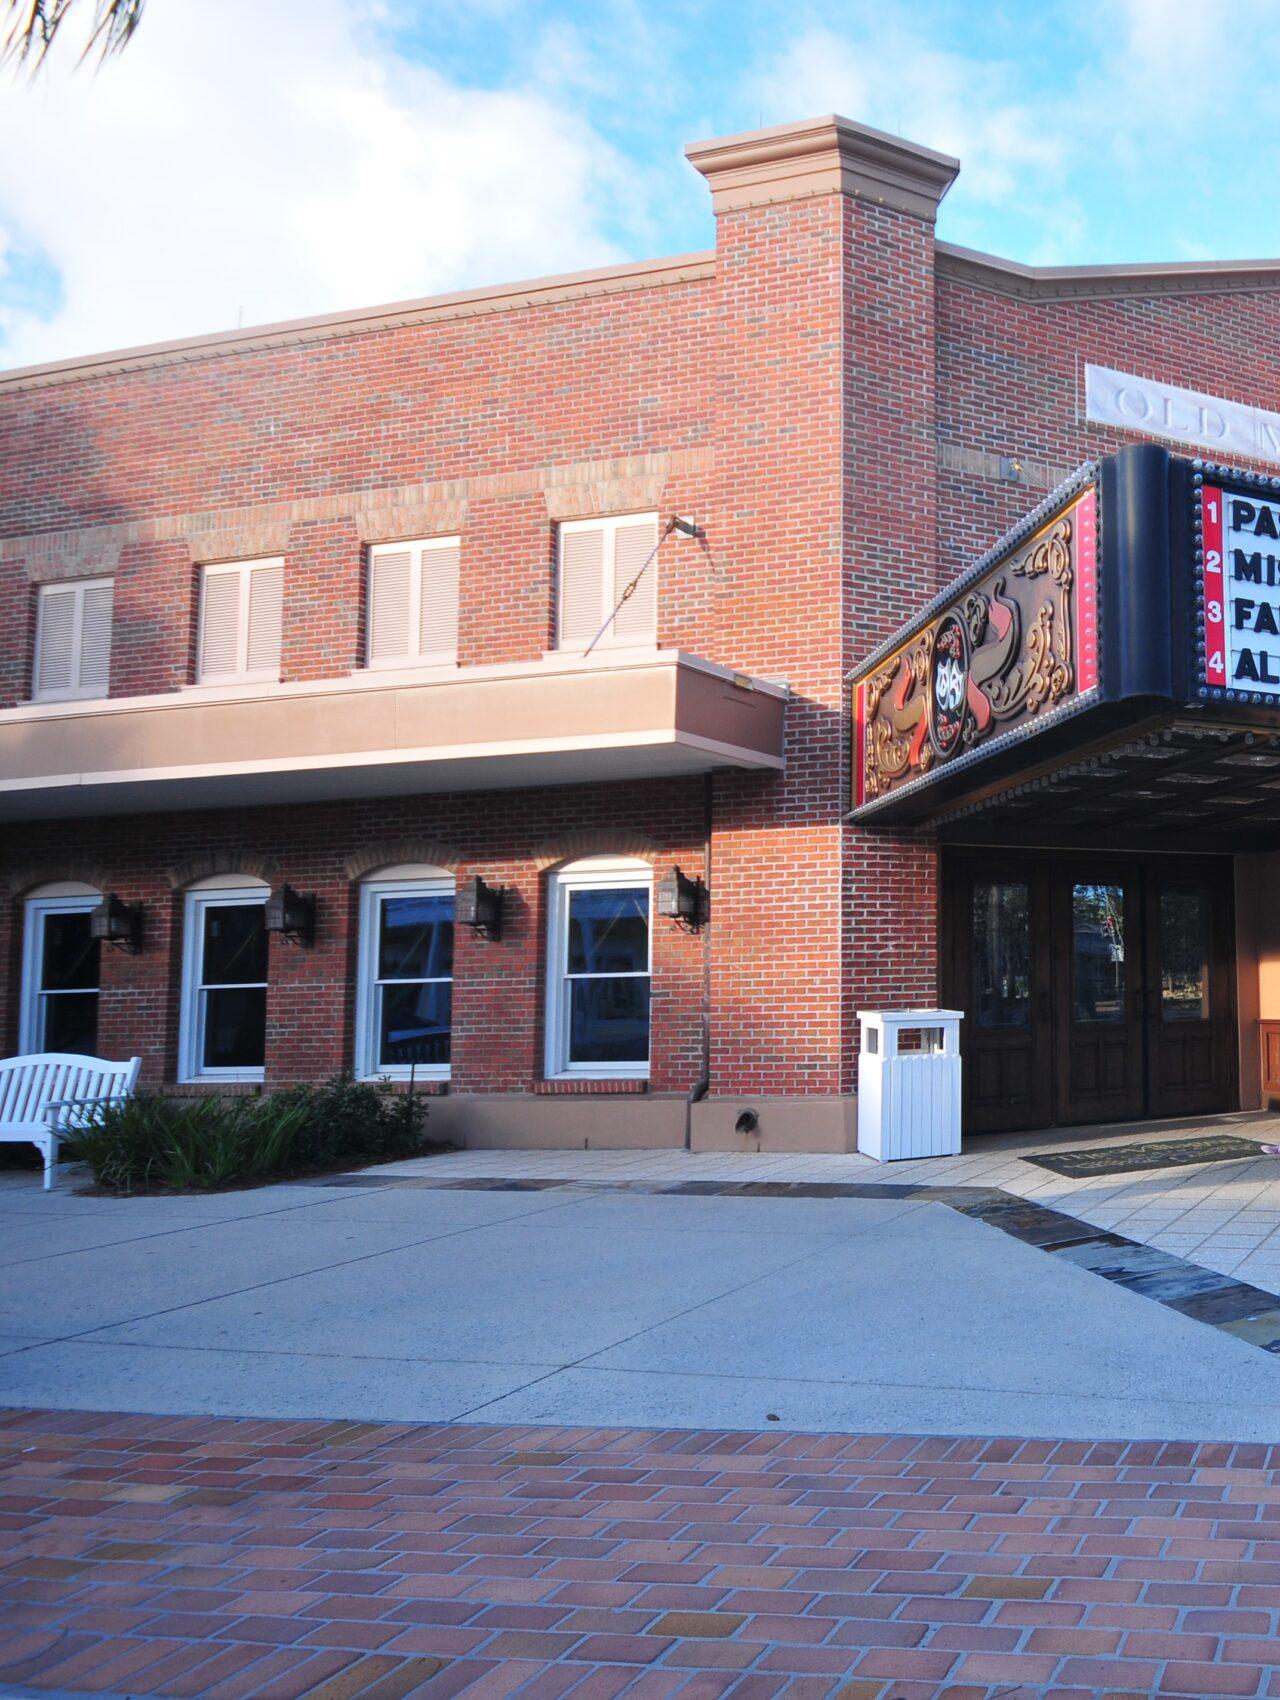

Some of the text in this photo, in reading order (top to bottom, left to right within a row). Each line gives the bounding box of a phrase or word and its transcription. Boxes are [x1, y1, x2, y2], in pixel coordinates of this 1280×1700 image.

[1115, 387, 1230, 439] OLD
[1207, 502, 1217, 523] 1
[1207, 552, 1220, 573] 2
[1208, 601, 1222, 623] 3
[1209, 652, 1223, 673] 4
